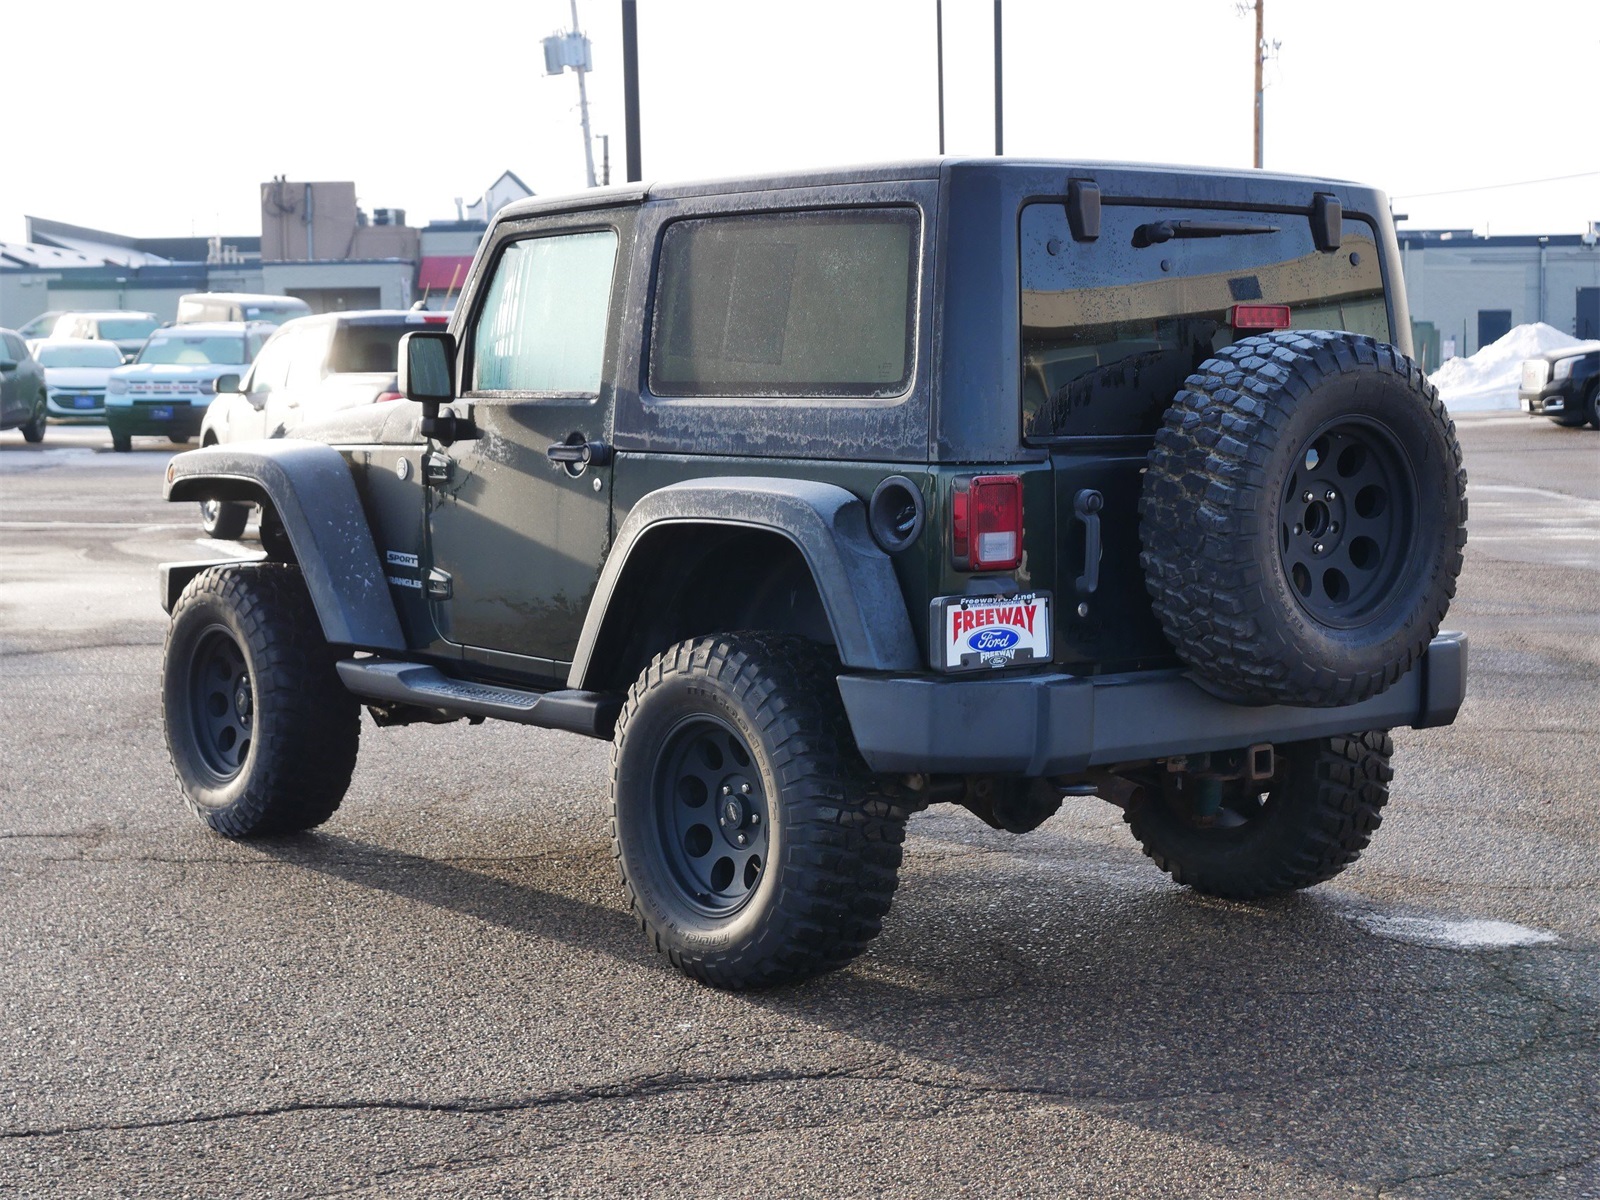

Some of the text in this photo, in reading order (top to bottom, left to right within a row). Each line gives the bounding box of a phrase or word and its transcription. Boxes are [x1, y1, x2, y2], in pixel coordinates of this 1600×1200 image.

[388, 553, 417, 565] SPORT
[388, 576, 422, 588] RANGLER
[960, 592, 1036, 604] Freewayd.net
[953, 605, 1037, 645] FREEWAY
[977, 631, 1009, 649] Ford
[980, 649, 1016, 664] FREEWAY
